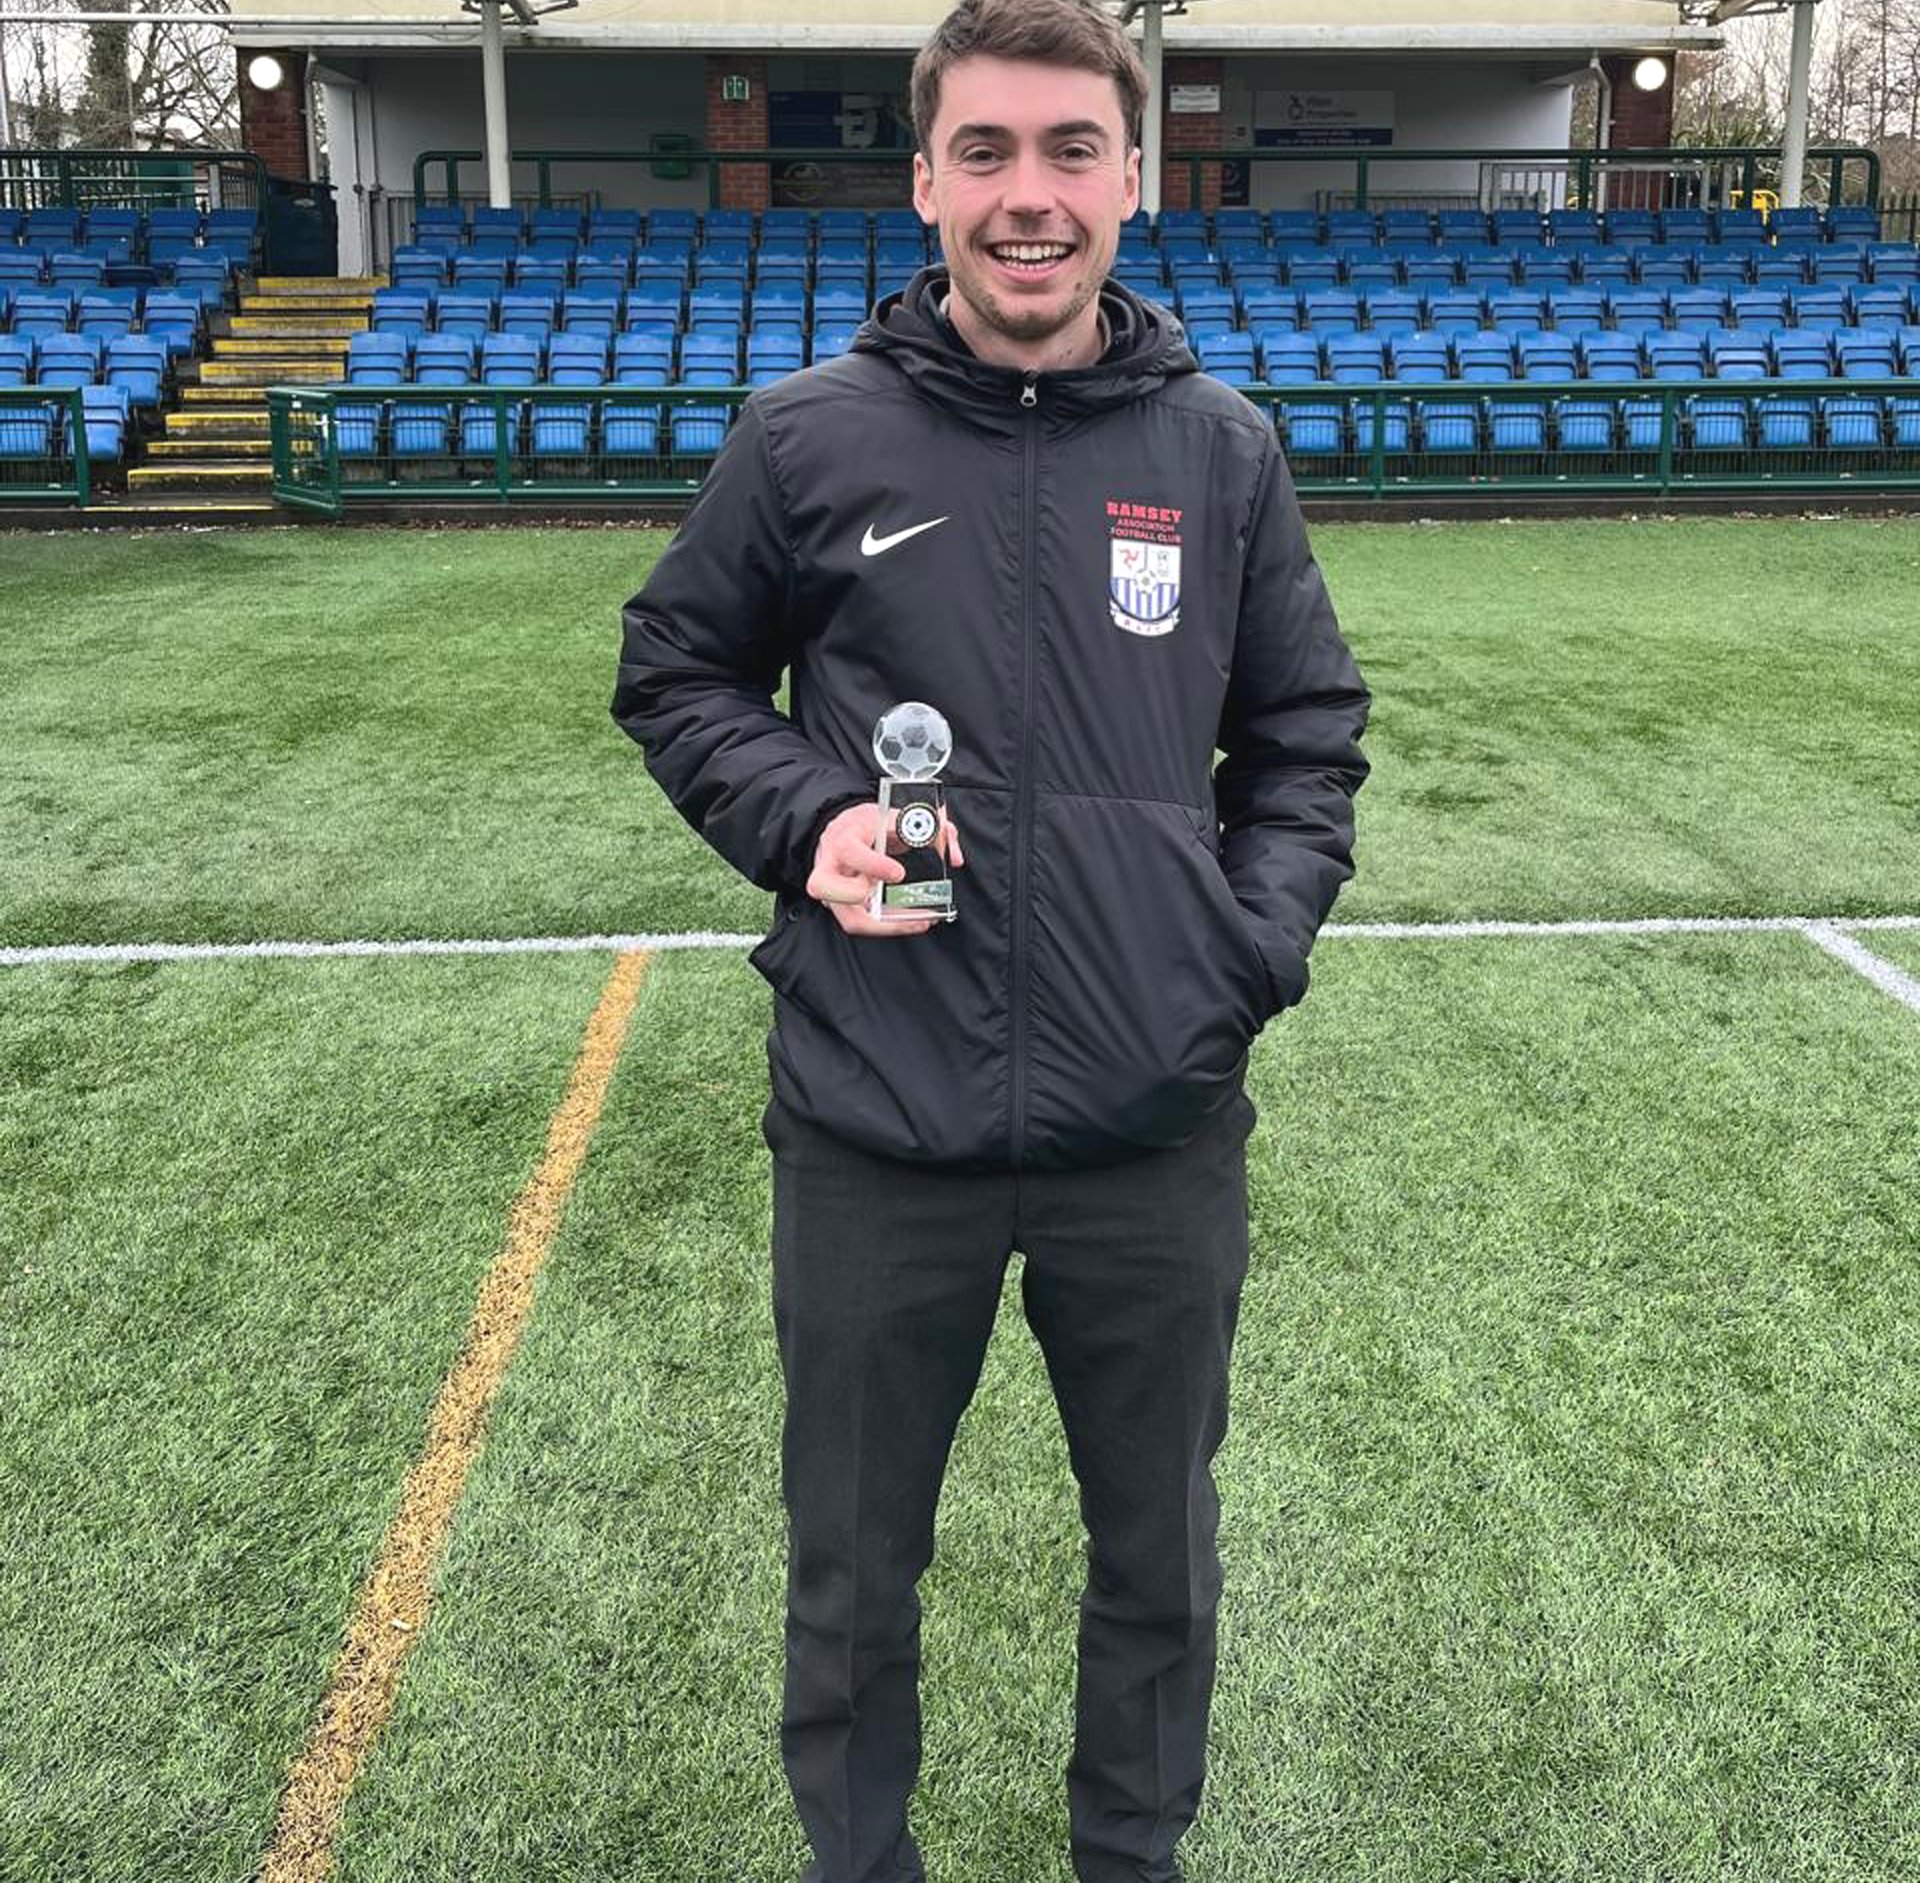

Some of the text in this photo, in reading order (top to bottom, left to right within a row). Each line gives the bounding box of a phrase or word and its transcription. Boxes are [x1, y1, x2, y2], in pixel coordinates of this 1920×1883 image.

[1106, 502, 1182, 523] RAMSEY
[1116, 519, 1175, 532] ASSOCIATION
[1110, 527, 1182, 543] FOOTBALL CLUB
